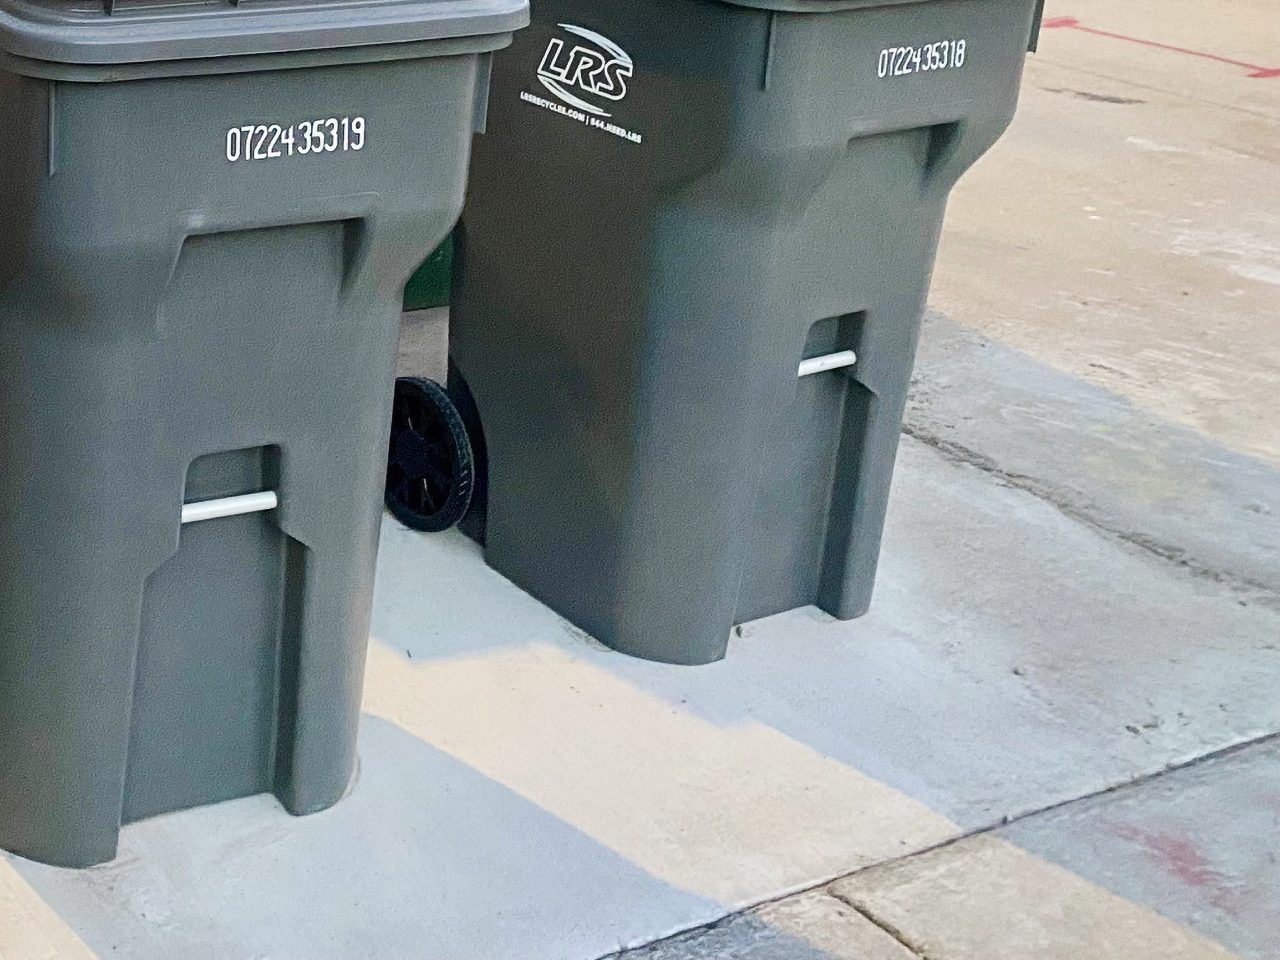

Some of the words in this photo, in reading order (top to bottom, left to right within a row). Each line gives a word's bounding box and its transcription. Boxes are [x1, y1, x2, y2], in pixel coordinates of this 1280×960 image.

[537, 37, 634, 101] LRS
[877, 39, 966, 78] 0722435318
[226, 116, 366, 162] 0722435319
